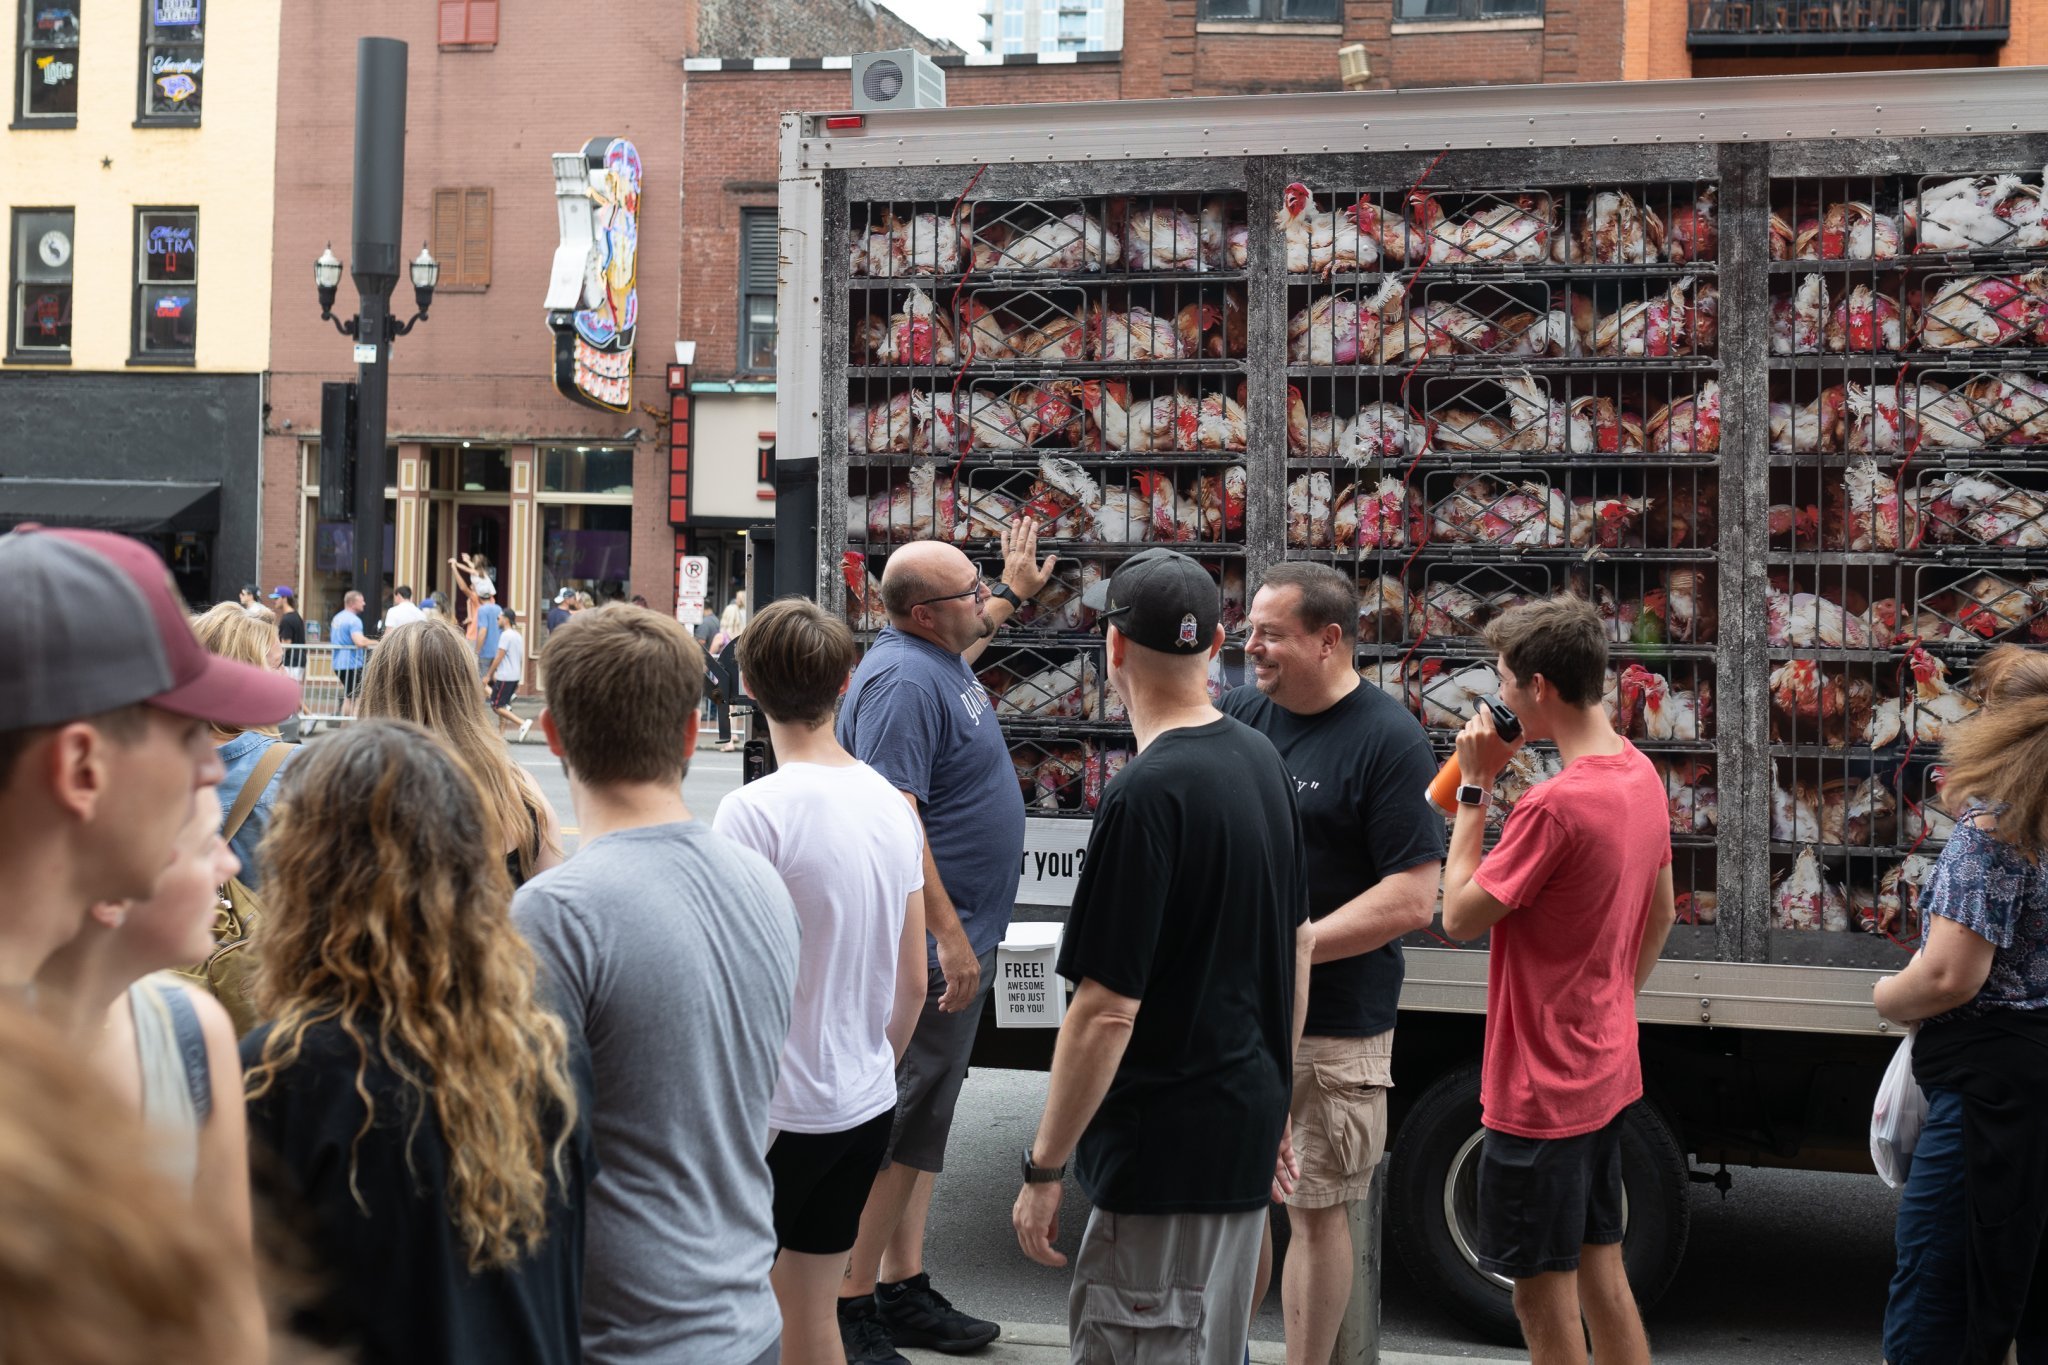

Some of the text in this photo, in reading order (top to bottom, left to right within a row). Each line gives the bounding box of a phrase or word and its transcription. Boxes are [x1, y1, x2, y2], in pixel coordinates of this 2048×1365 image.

[147, 239, 195, 254] ULTRA
[1034, 848, 1087, 882] you?
[1004, 962, 1045, 978] FREE!
[1007, 981, 1045, 991] AWESOME
[1008, 992, 1046, 1002] INFO JUST
[1009, 1004, 1045, 1013] FOR YOU!
